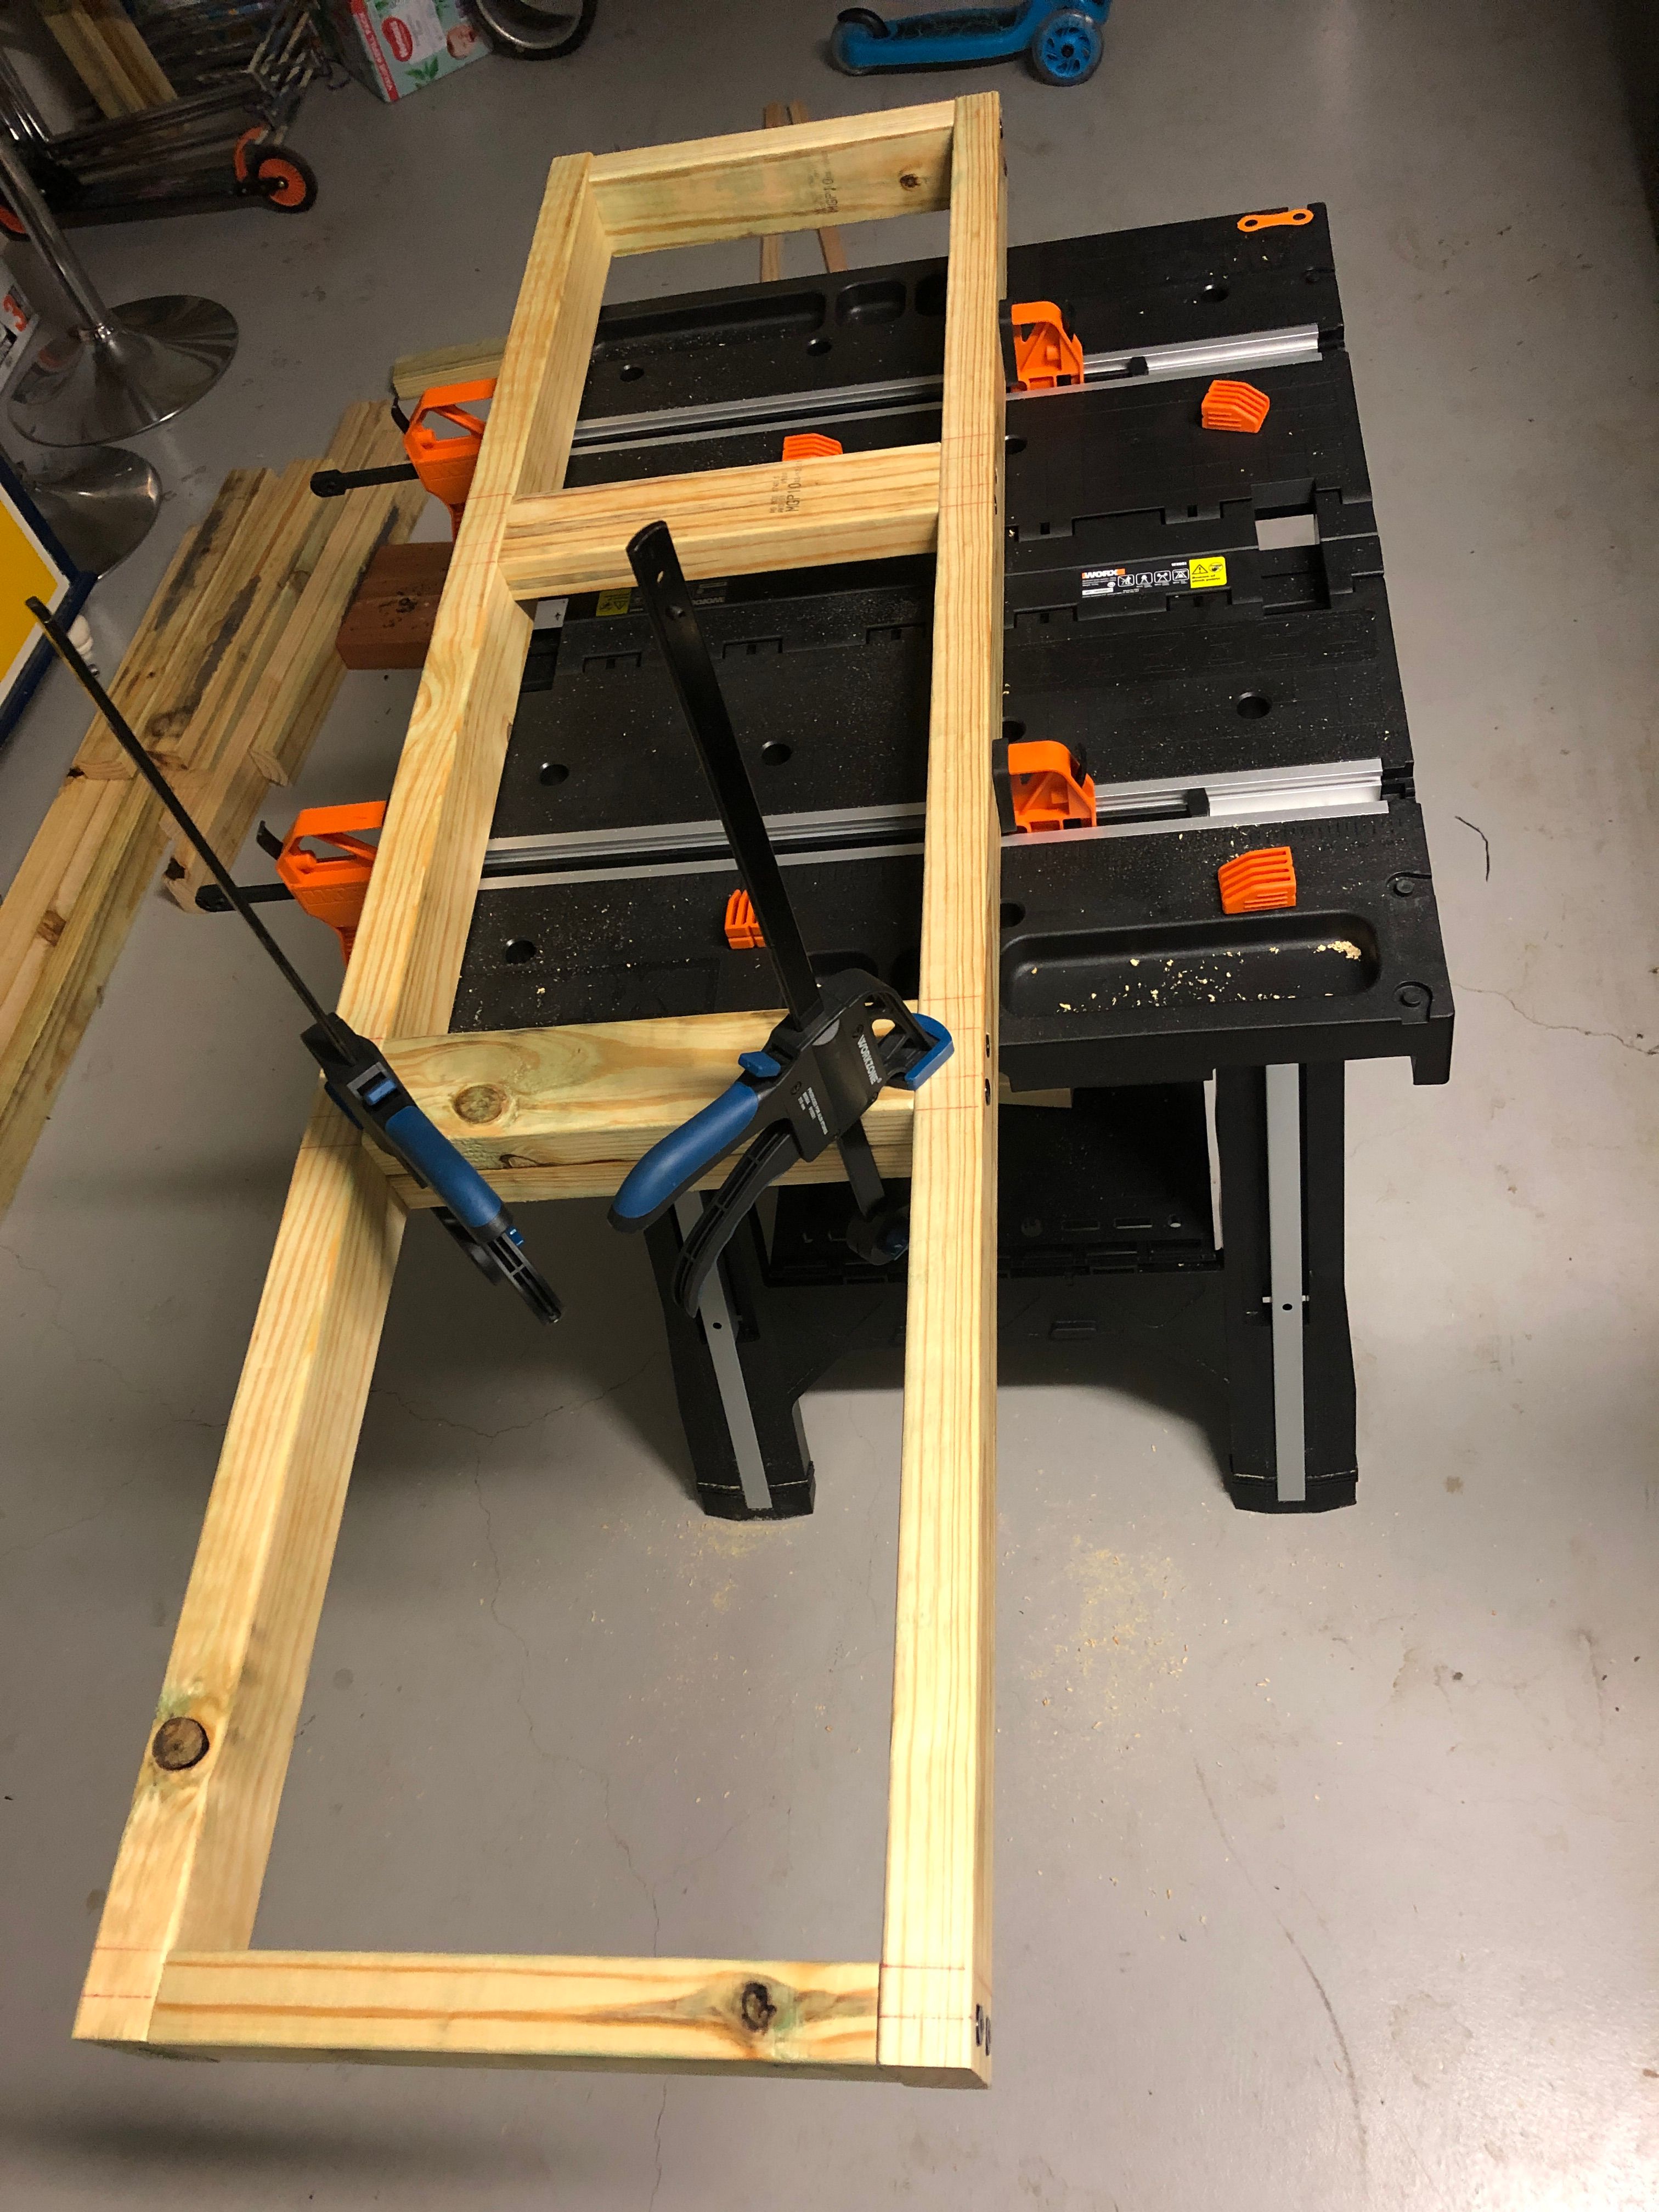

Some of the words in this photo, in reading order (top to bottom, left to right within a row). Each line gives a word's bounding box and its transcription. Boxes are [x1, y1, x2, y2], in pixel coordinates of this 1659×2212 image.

[786, 483, 801, 512] MGP10
[1085, 569, 1118, 579] WORX
[857, 1034, 878, 1085] WORKZONE
